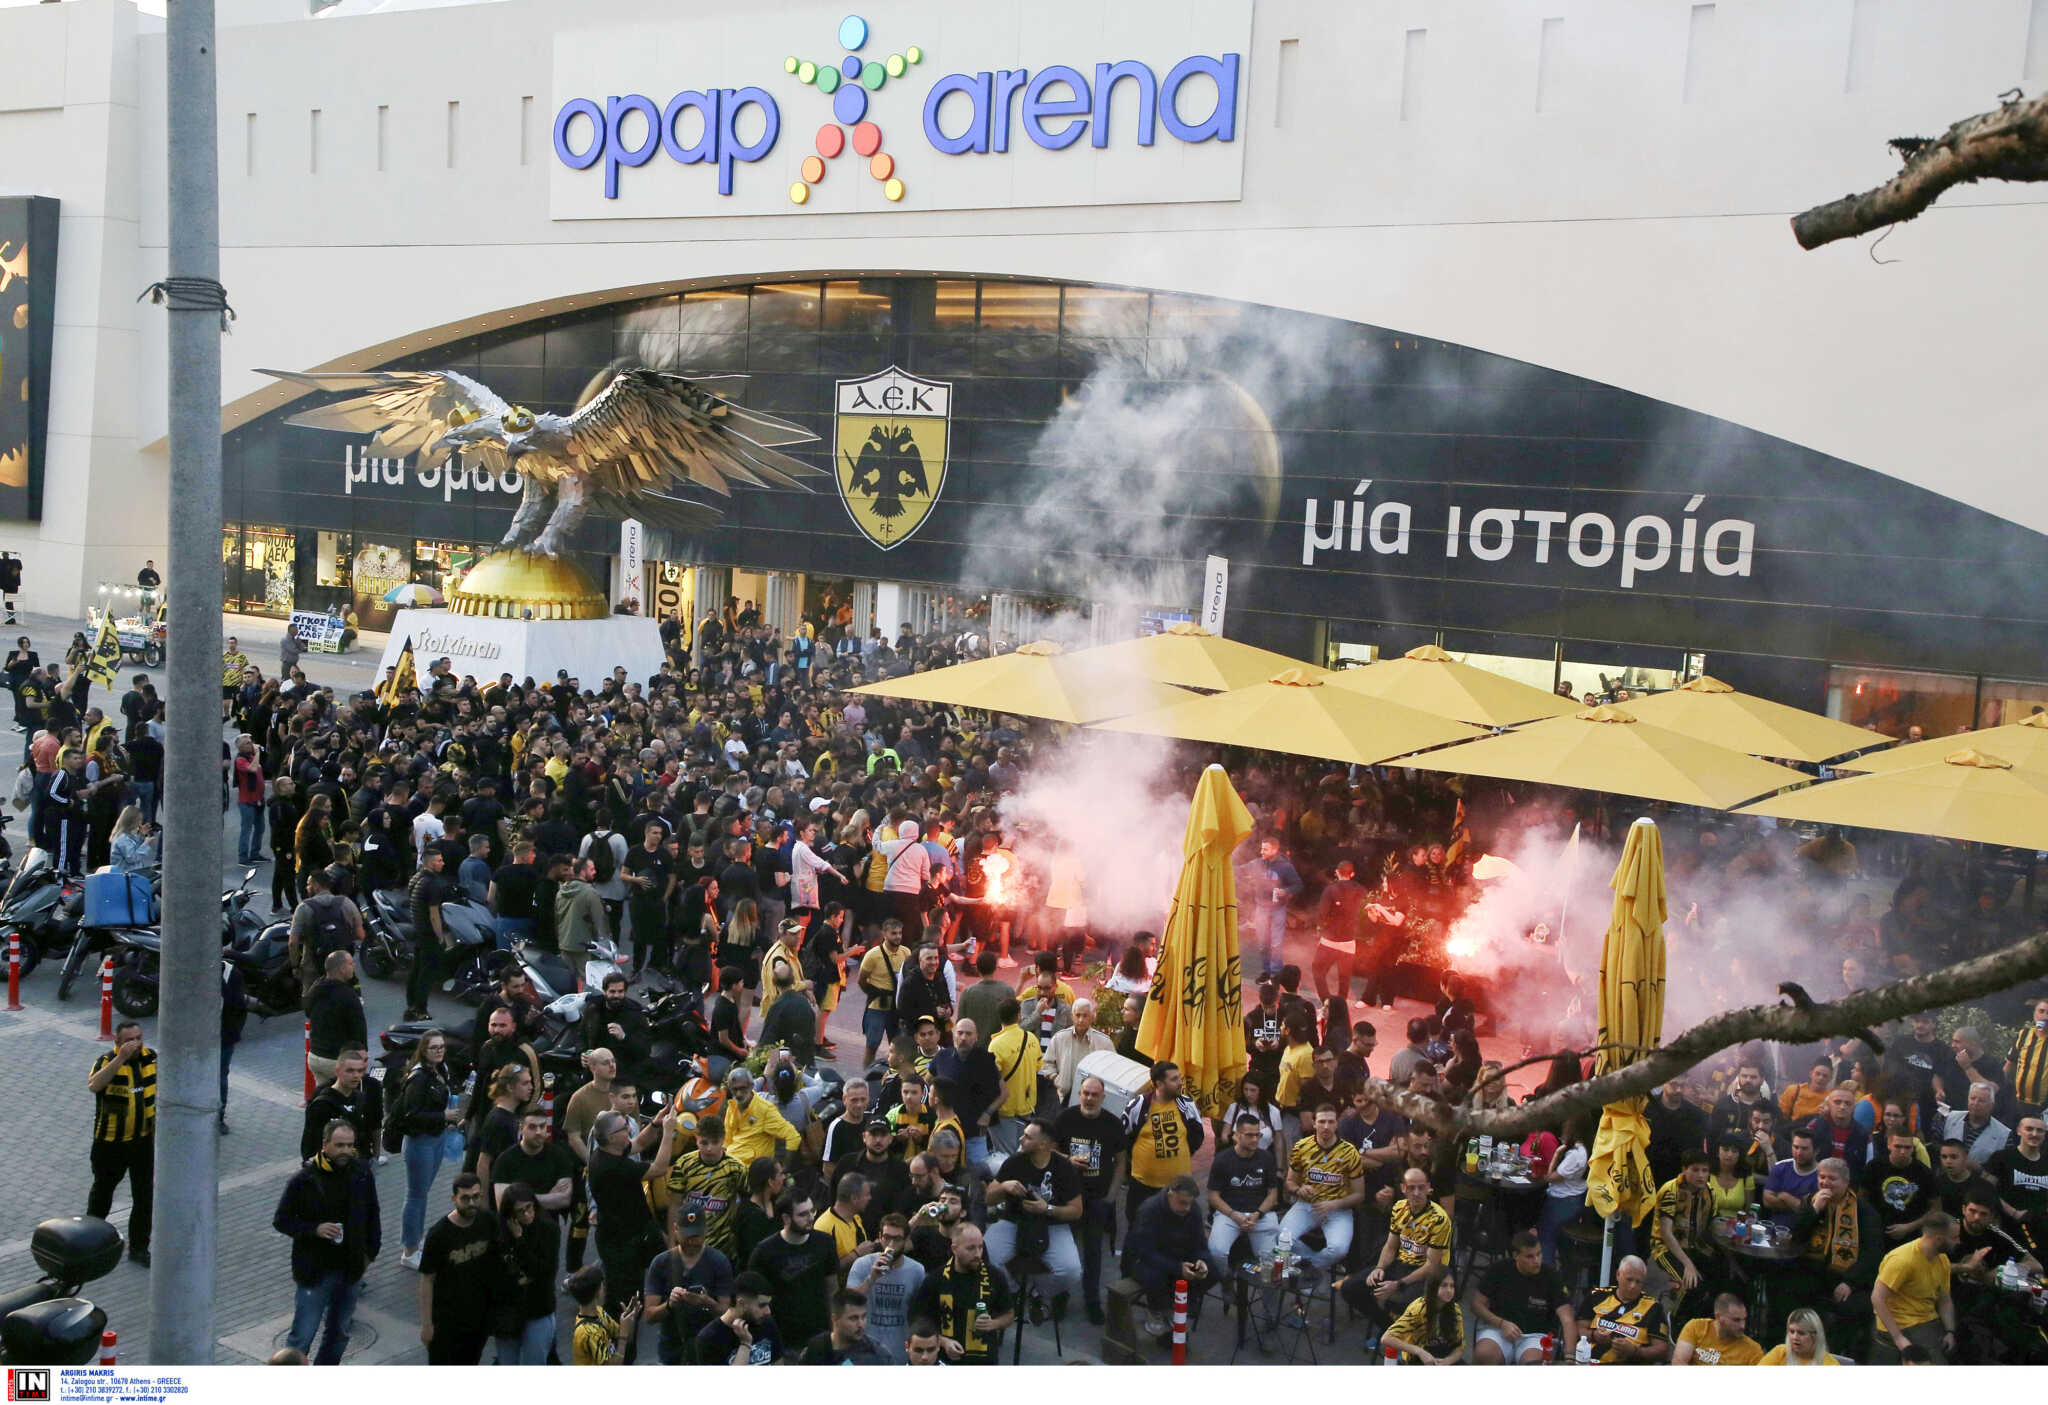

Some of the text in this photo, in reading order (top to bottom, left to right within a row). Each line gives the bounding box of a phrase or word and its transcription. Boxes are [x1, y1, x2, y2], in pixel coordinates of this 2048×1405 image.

[553, 53, 1241, 200] opap arena
[629, 525, 637, 569] arena
[1302, 479, 1756, 589] μία ιστορία
[1210, 572, 1224, 624] arena
